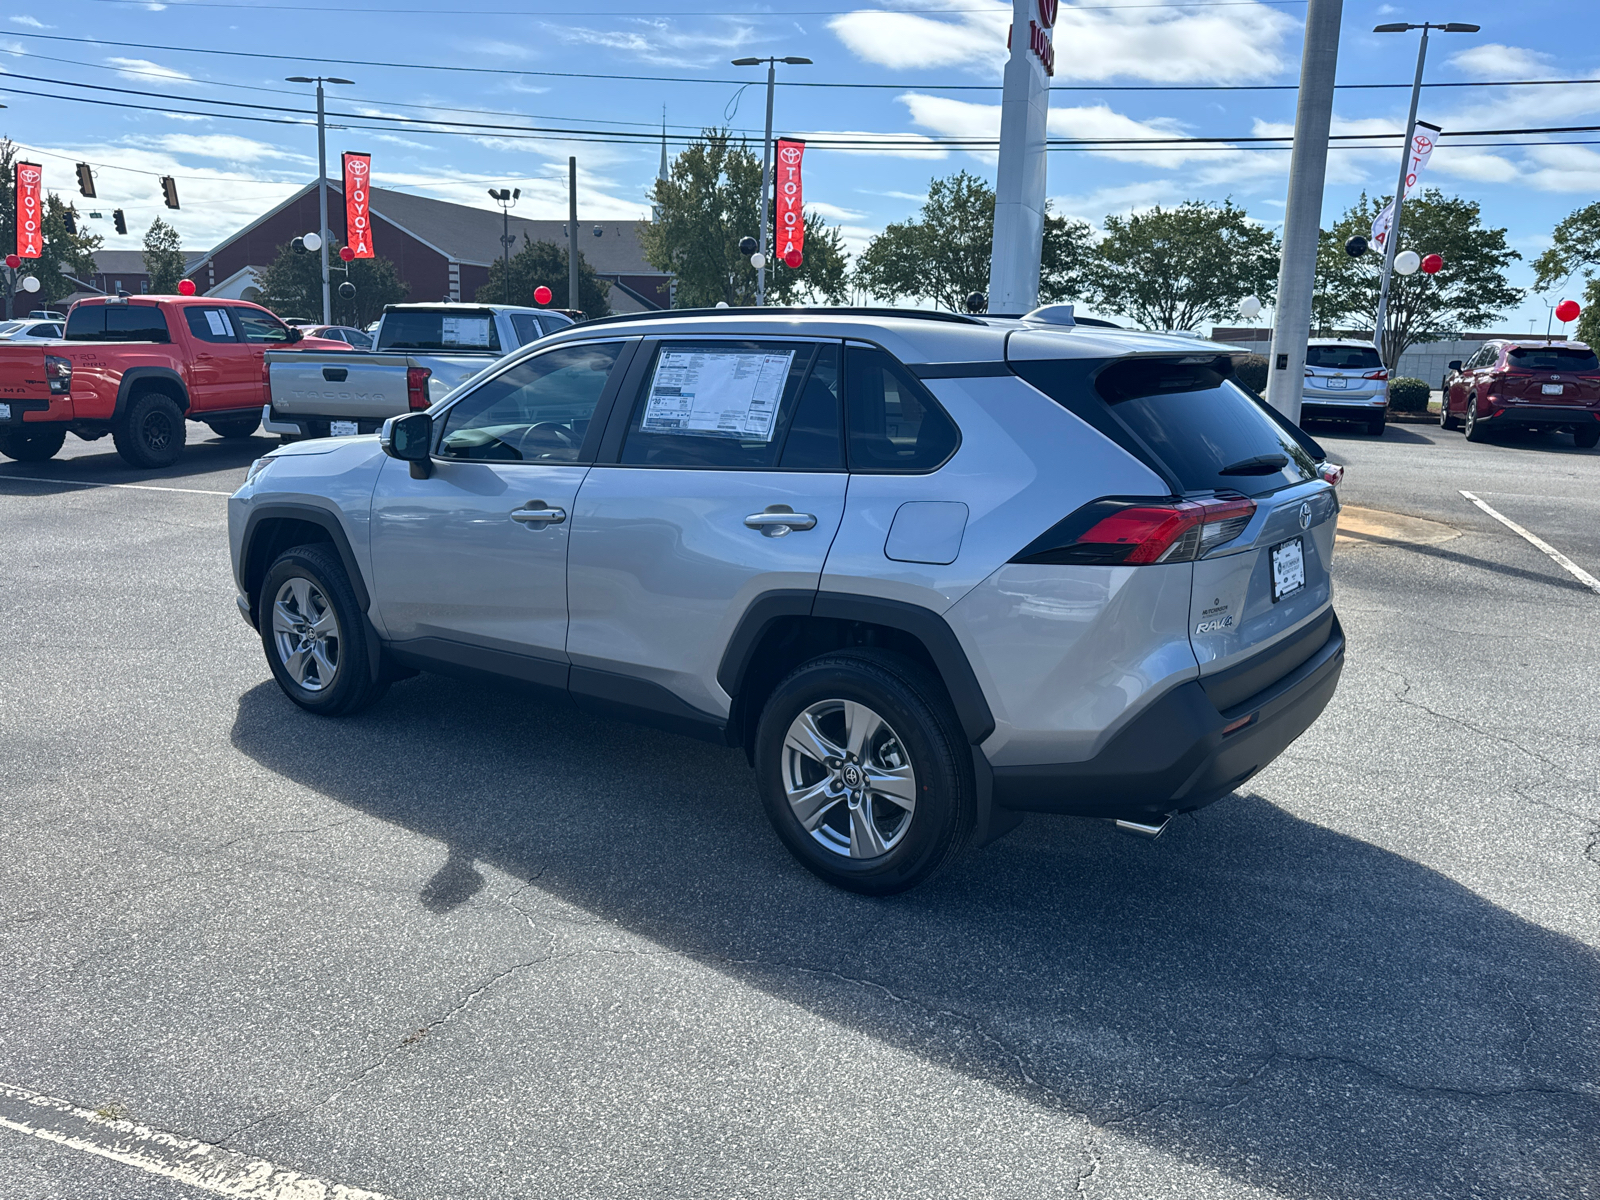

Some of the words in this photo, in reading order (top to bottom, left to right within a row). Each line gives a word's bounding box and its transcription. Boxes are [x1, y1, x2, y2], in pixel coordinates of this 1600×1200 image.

[24, 184, 37, 255] TOYOTA
[353, 177, 368, 254] TOYOTA
[784, 167, 797, 254] TOYOTA
[291, 390, 386, 401] TACOMA
[1195, 615, 1233, 635] RAV4
